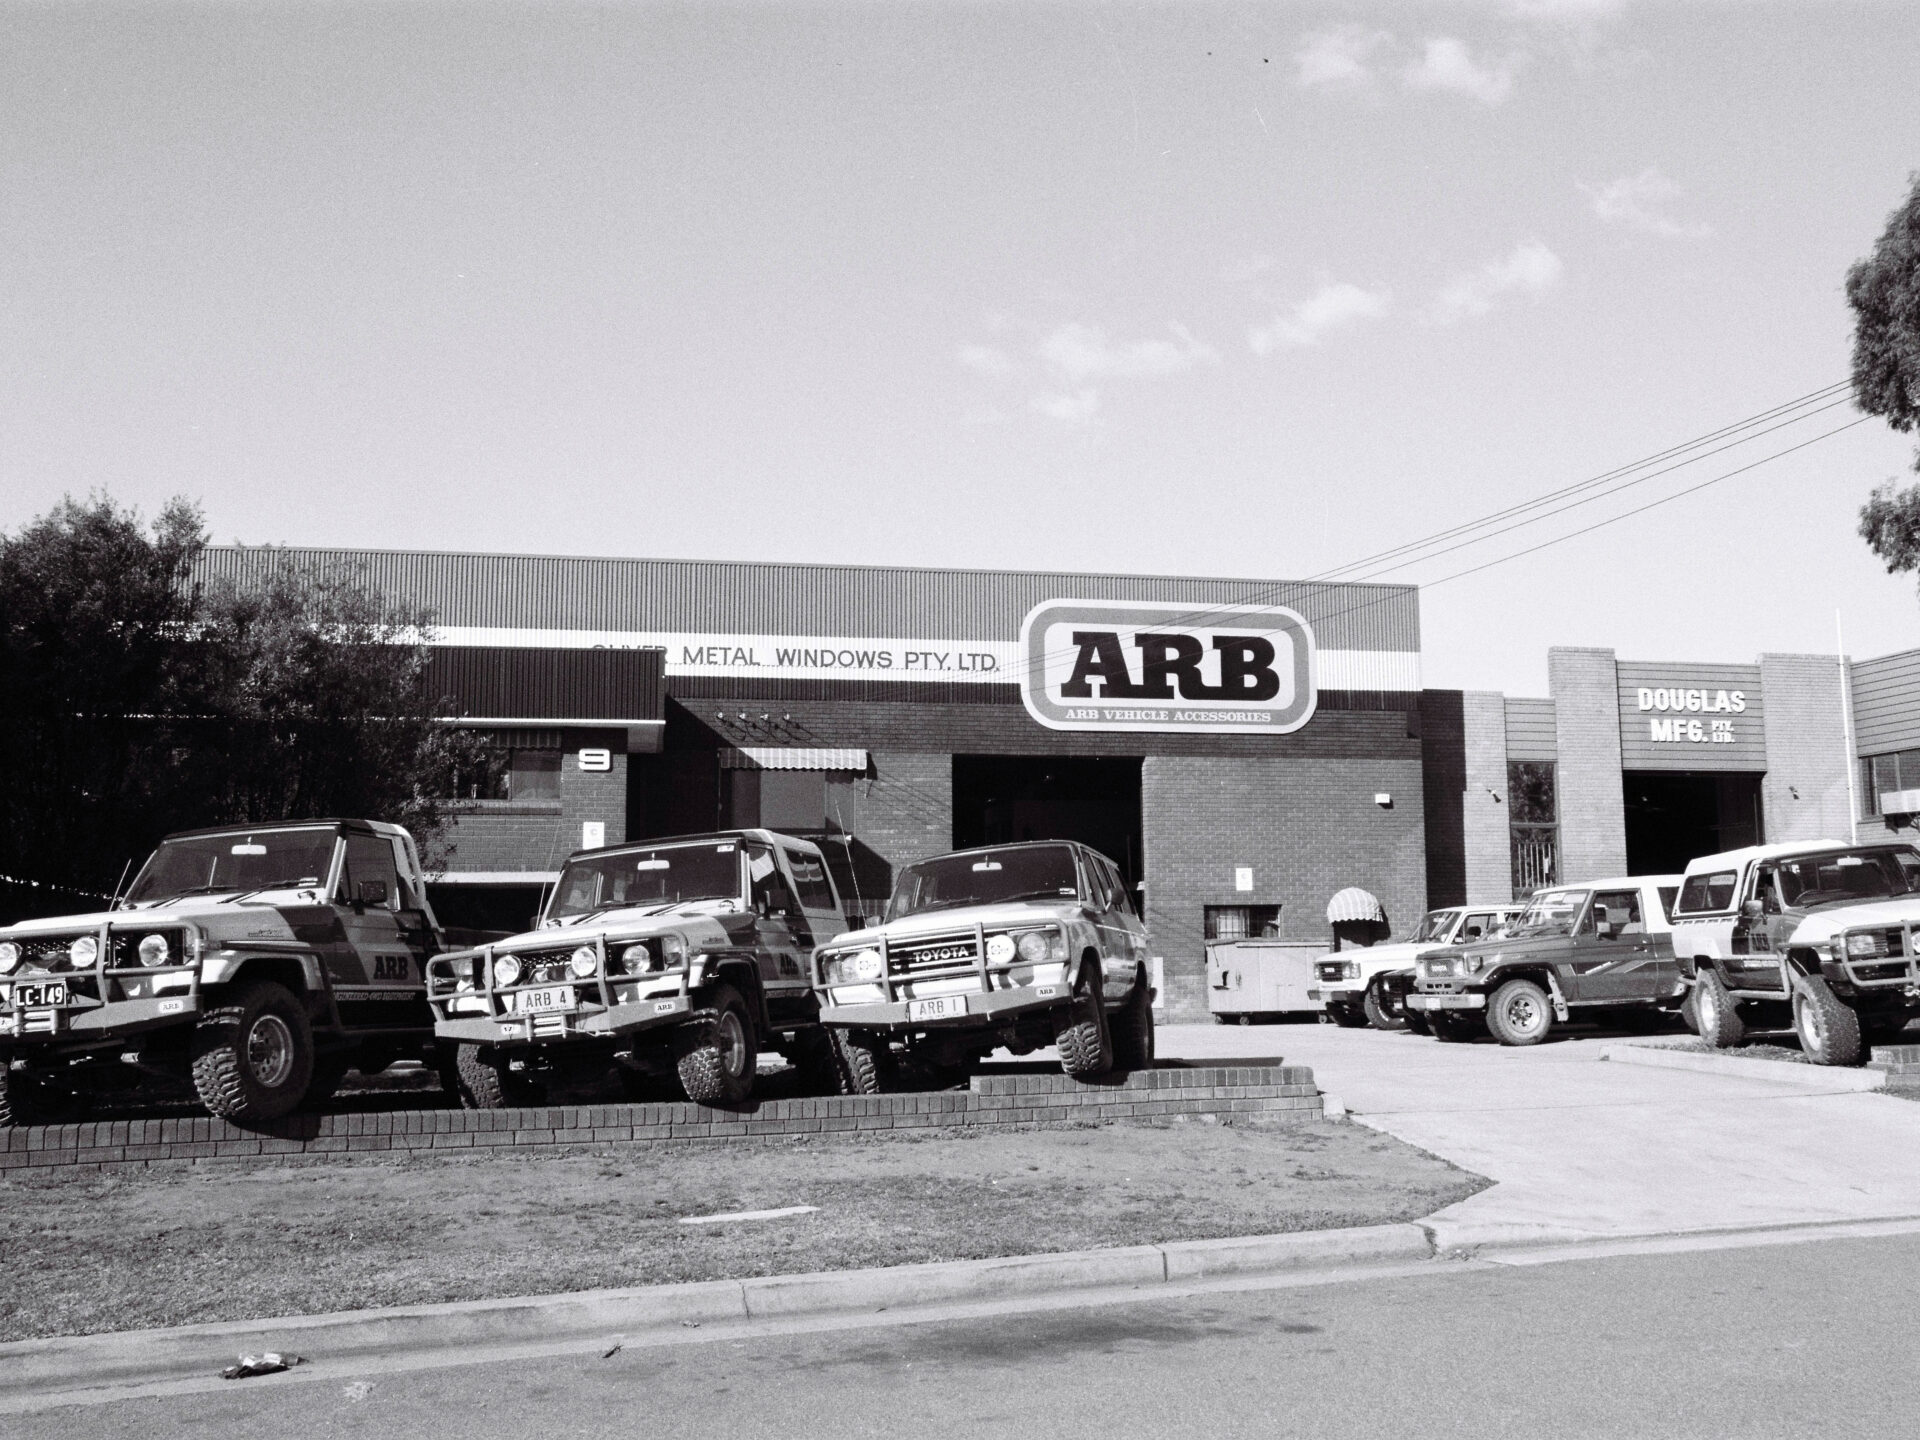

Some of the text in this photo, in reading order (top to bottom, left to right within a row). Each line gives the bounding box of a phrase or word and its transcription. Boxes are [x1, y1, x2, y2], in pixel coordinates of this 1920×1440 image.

[683, 646, 760, 666] METAL
[776, 648, 893, 669] WINDOWS
[1060, 631, 1280, 702] ARB
[1637, 688, 1746, 713] DOUGLAS
[1065, 708, 1271, 722] ARB VEHICLE ACCESSORIES
[1650, 718, 1709, 743] MFG.
[913, 946, 969, 962] TOYOTA
[373, 955, 409, 980] ARB
[525, 992, 567, 1008] ARB 4
[919, 999, 944, 1015] ARB
